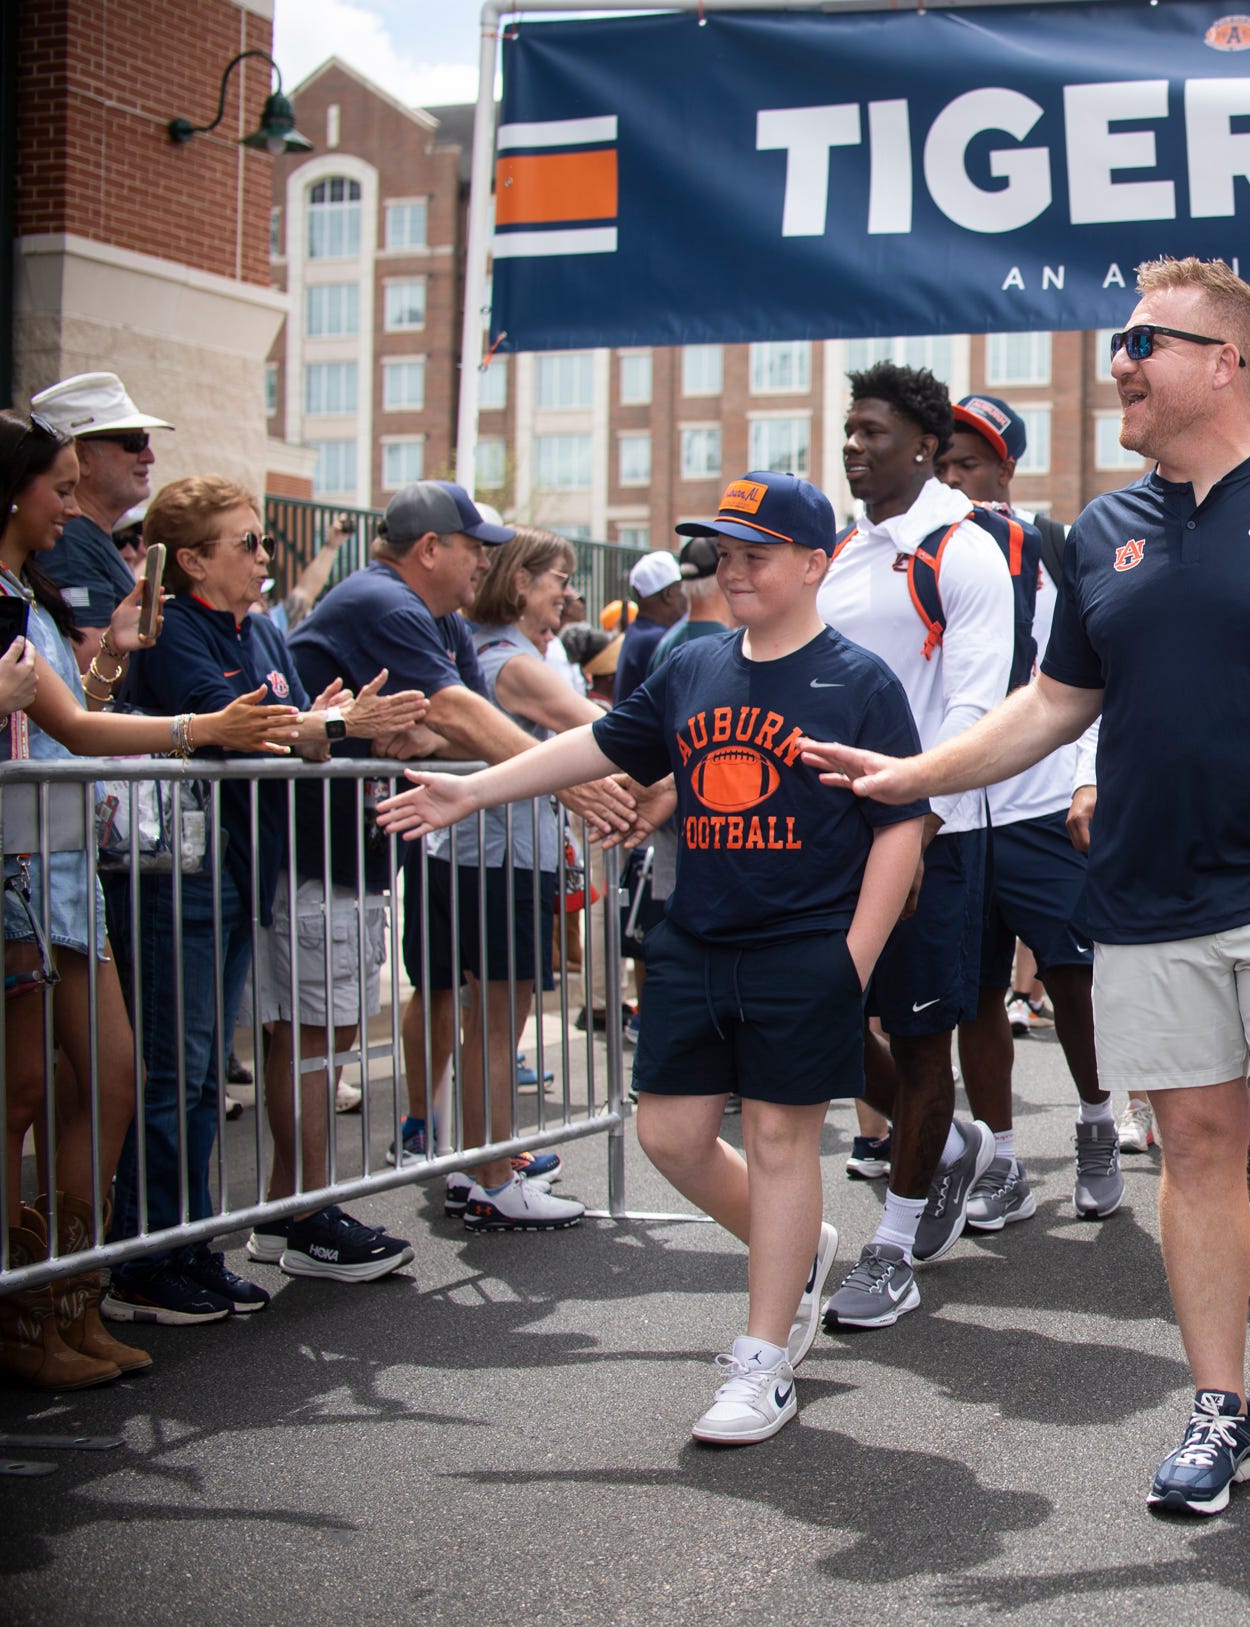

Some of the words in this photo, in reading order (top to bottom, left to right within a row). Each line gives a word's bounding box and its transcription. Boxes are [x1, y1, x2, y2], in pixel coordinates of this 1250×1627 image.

[1001, 265, 1065, 290] AN
[676, 706, 803, 767] AUBURN
[682, 815, 803, 849] OOTBALL
[309, 1243, 339, 1261] HOKA
